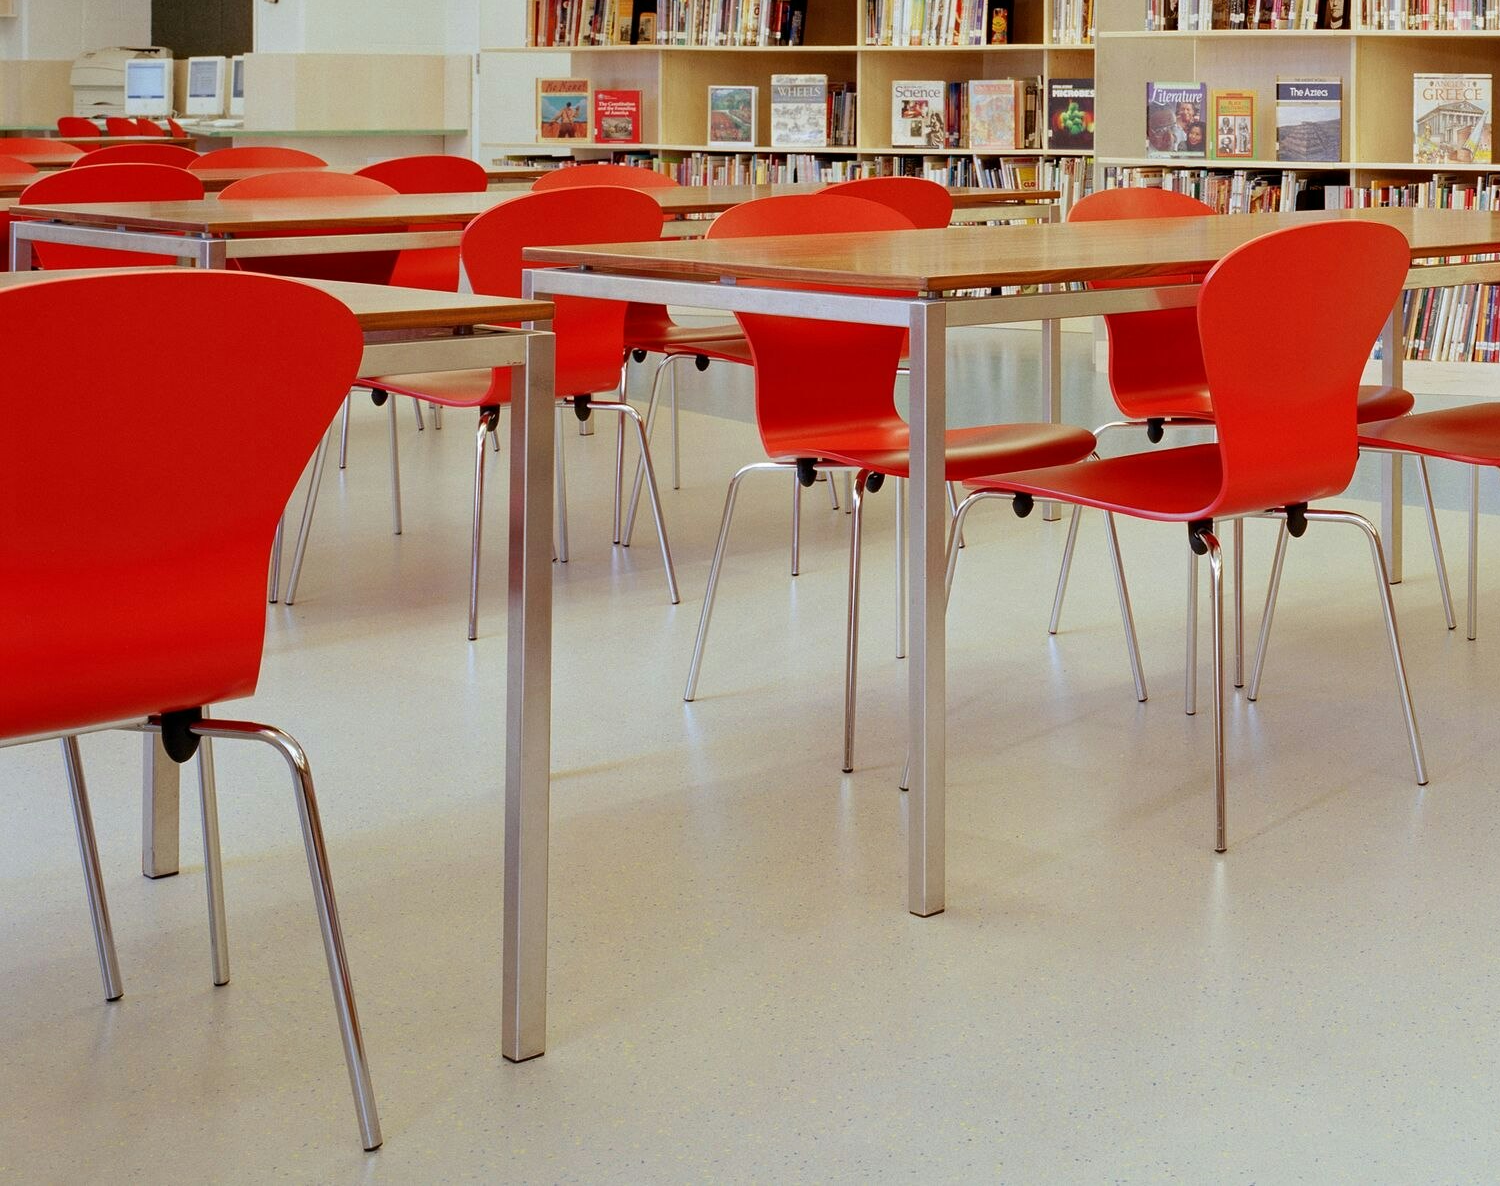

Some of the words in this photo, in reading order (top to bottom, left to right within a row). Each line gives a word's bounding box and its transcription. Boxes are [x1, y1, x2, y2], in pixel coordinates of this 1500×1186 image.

[777, 86, 821, 97] WHEELS
[895, 86, 941, 99] Science
[1150, 87, 1203, 105] Literature
[1290, 87, 1304, 97] The
[1304, 87, 1329, 97] Aztecs
[1423, 88, 1483, 100] GREECE
